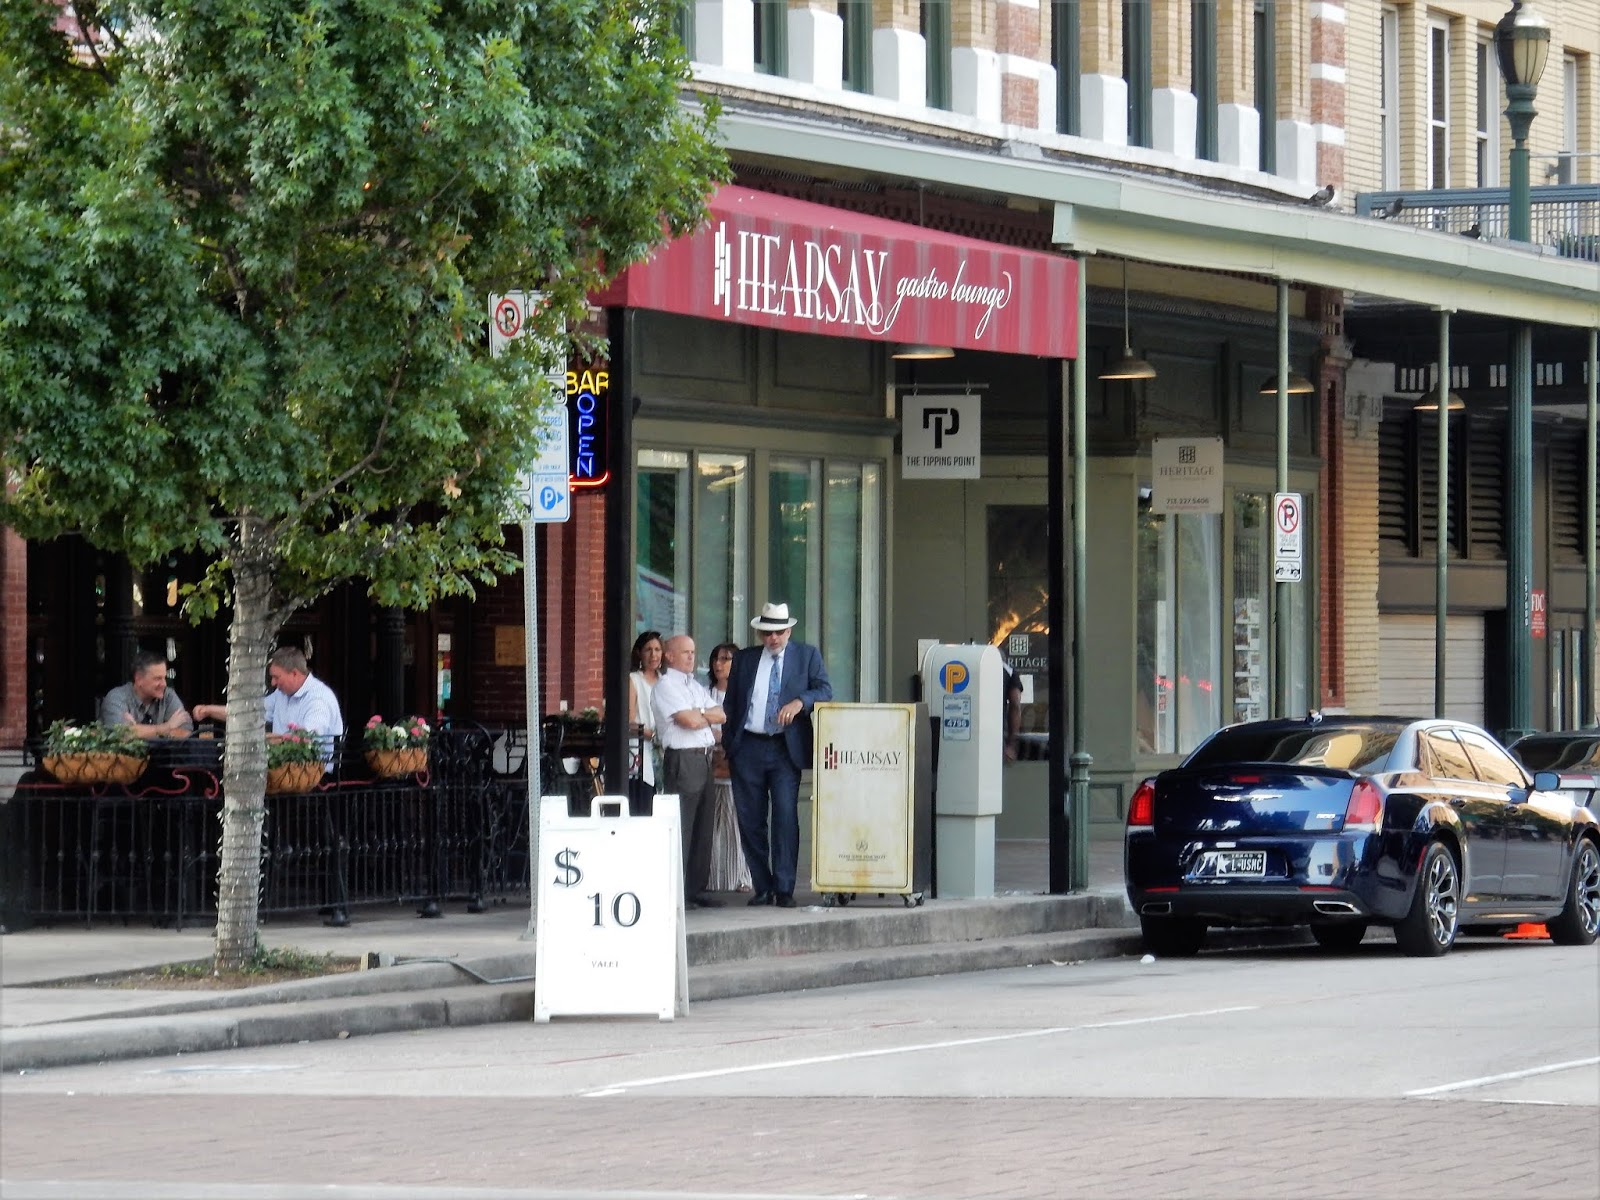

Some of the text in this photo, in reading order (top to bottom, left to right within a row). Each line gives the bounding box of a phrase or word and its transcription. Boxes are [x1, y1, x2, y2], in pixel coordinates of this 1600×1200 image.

[737, 230, 1012, 339] HEARSAY gastro lounge
[577, 393, 595, 477] OPEN
[907, 456, 976, 466] THE TIPPING POINT
[1160, 466, 1215, 476] HERITAGE
[1531, 593, 1545, 612] FDC
[1007, 657, 1048, 668] RITAGE
[840, 750, 901, 765] HEARSAY
[553, 847, 583, 888] $
[587, 891, 641, 928] 10
